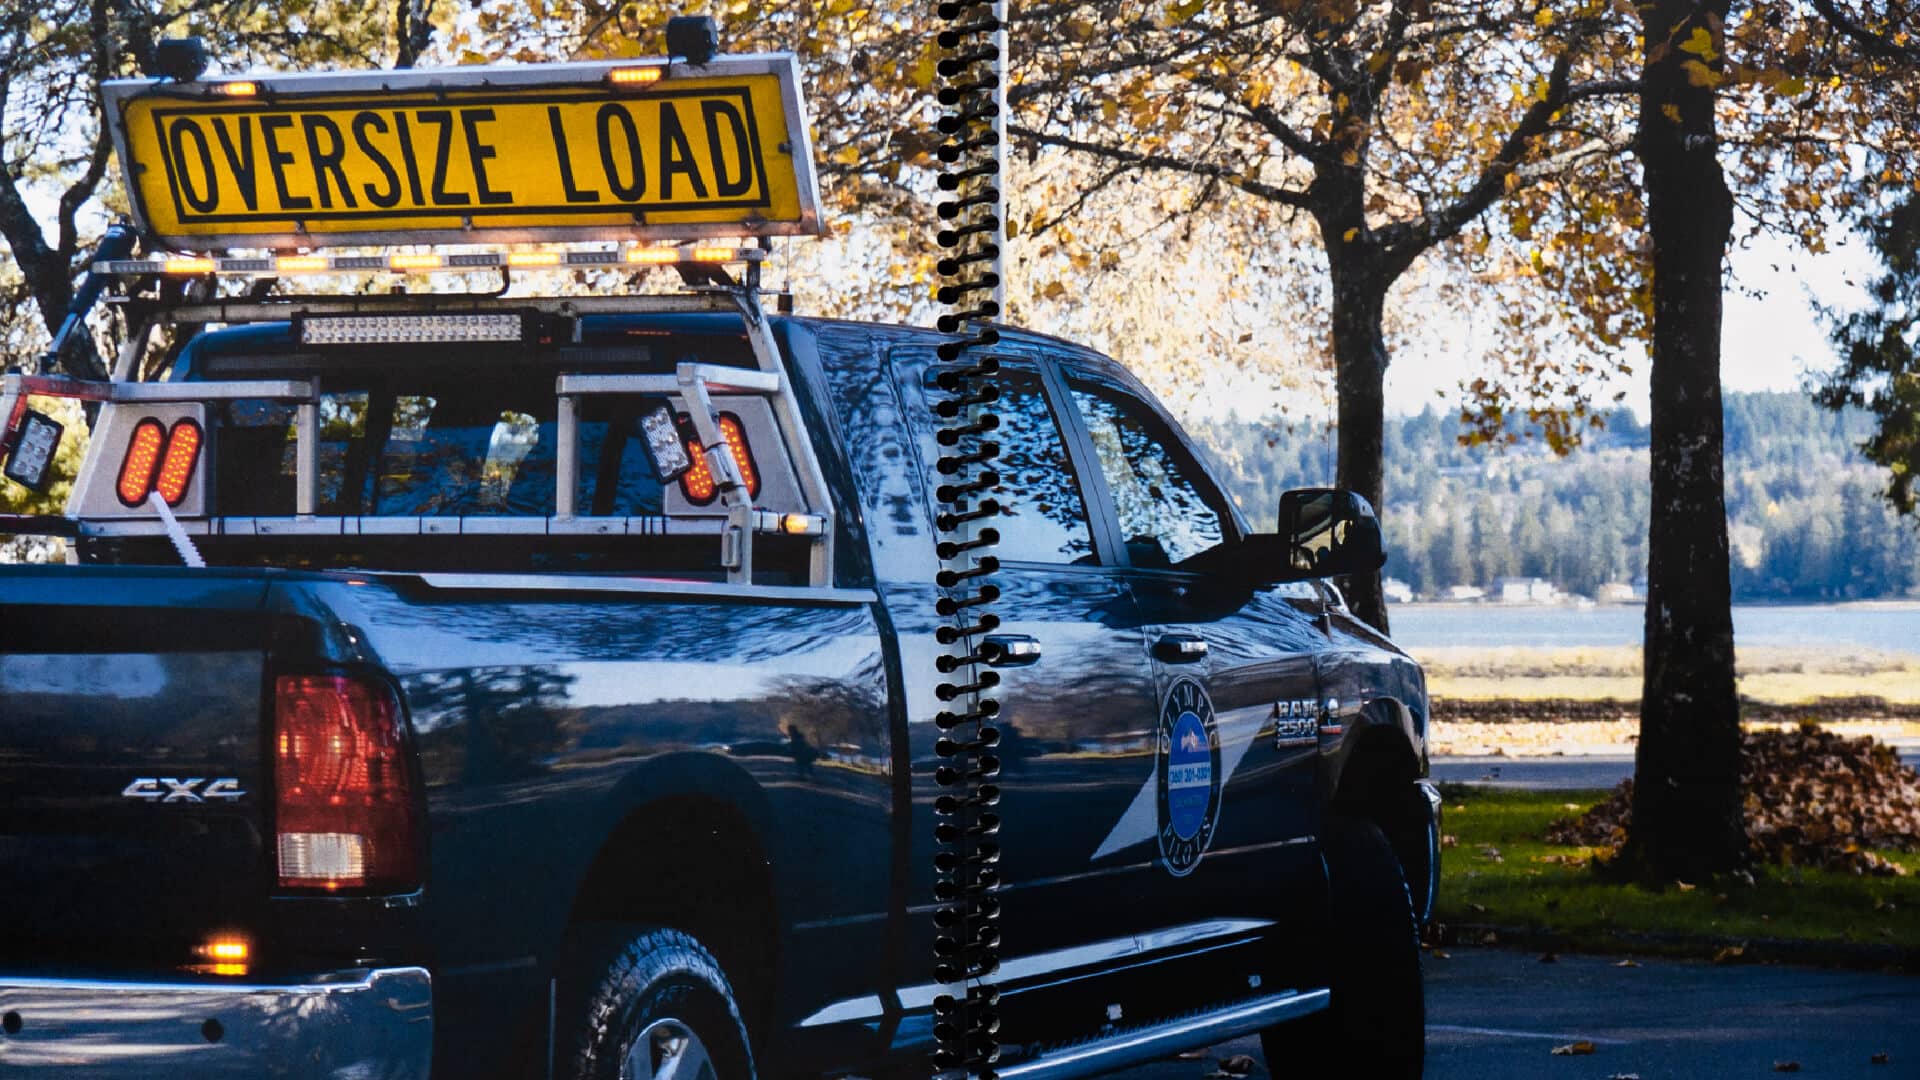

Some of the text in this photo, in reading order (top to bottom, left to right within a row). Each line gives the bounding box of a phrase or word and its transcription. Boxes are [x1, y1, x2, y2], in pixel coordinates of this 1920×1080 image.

[168, 100, 754, 214] OVERSIZE LOAD
[1278, 718, 1318, 736] 2500
[1162, 815, 1211, 864] PILOTS
